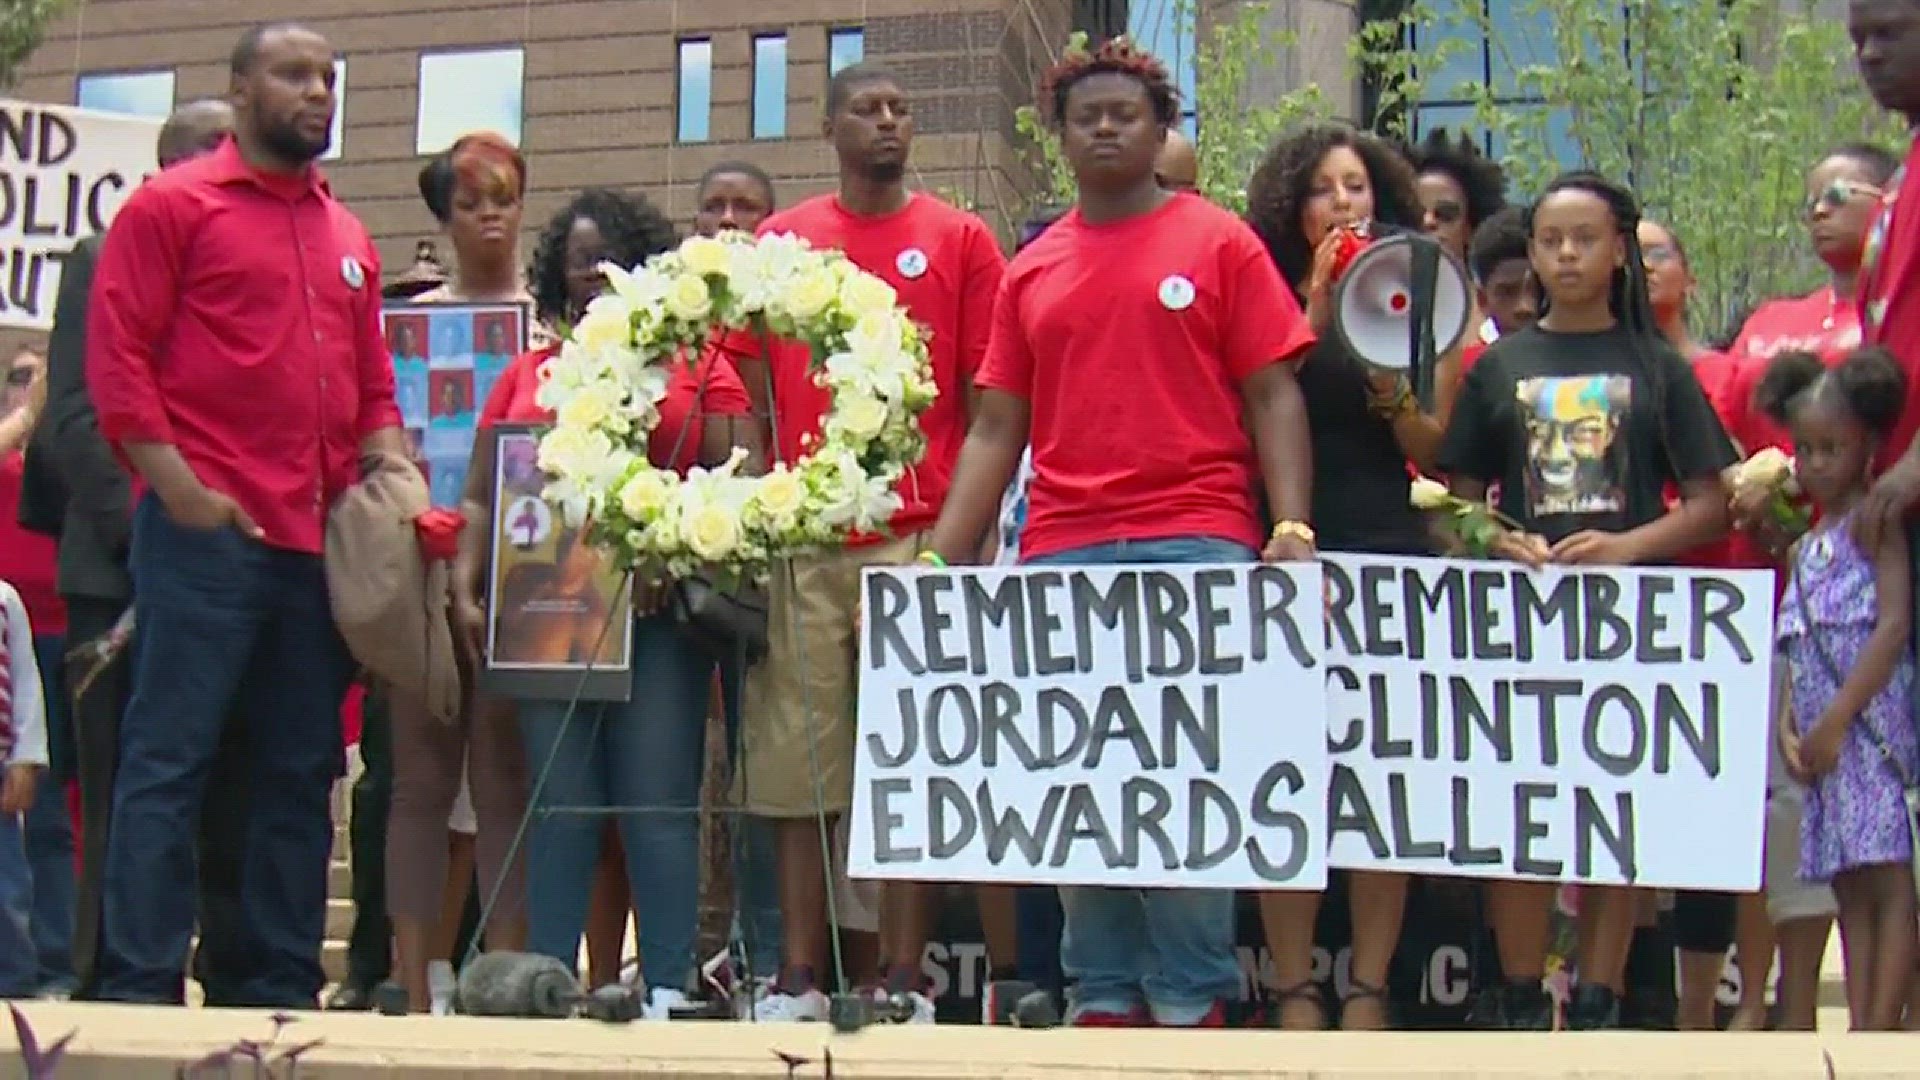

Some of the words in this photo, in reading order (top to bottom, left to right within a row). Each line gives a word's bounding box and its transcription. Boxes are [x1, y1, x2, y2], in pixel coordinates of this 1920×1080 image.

[867, 565, 1316, 683] REMEMBER
[1322, 558, 1754, 665] REMEMBER
[866, 681, 1220, 773] JORDAN
[1325, 664, 1721, 780] CLINTON
[871, 761, 1309, 883] EDWARDS
[1326, 763, 1638, 884] ALLEN
